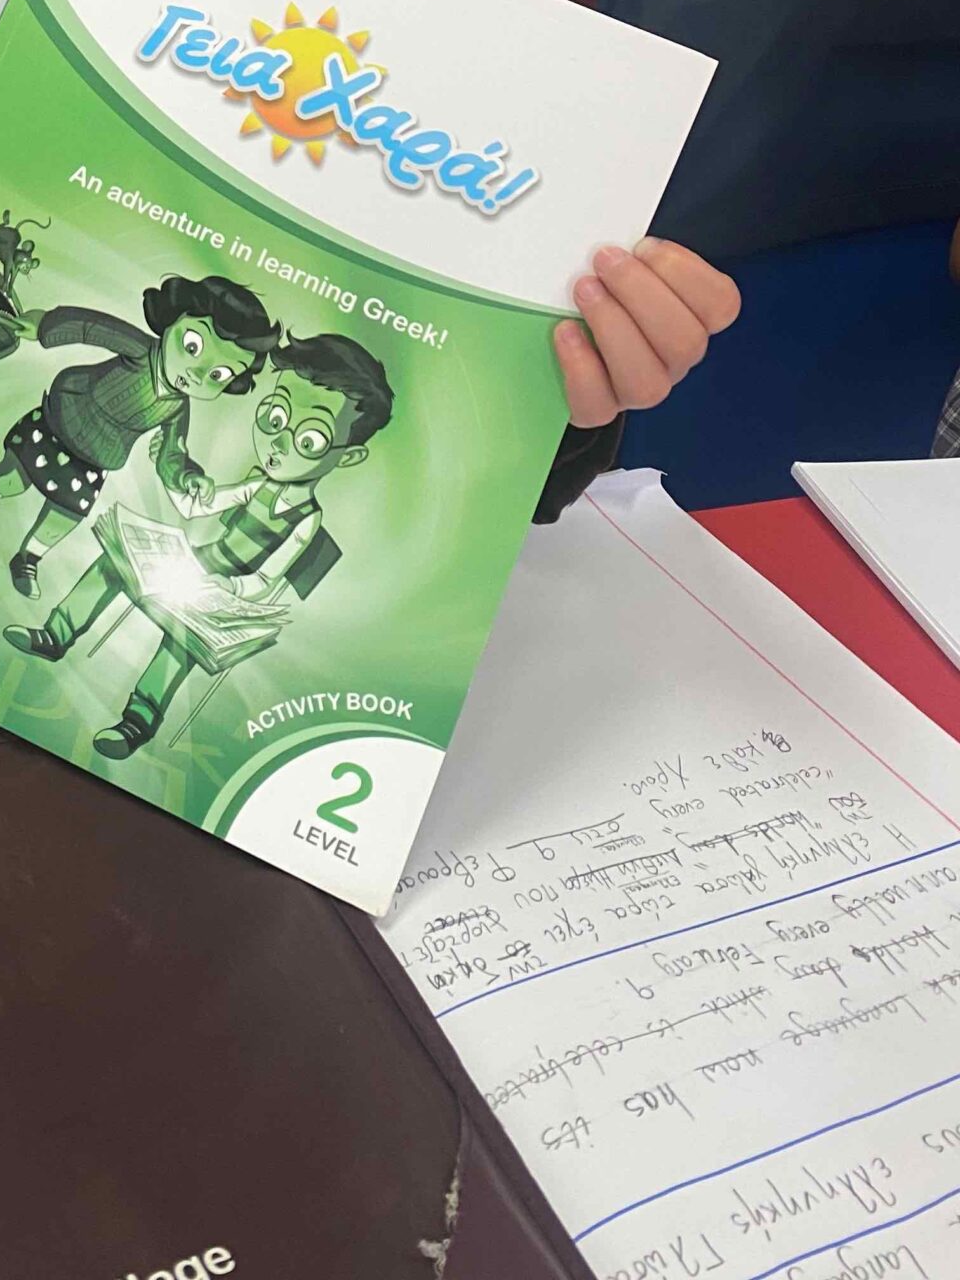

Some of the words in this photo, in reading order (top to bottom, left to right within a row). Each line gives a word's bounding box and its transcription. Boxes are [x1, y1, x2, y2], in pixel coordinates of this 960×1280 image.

[140, 4, 286, 96] Γεια
[299, 57, 537, 211] Χαρά!
[68, 163, 104, 194] An
[106, 176, 227, 251] adventure
[230, 234, 254, 265] in
[256, 245, 358, 315] learning
[361, 295, 451, 352] Greek!
[246, 692, 341, 739] ACTIVITY
[346, 692, 414, 721] BOOK
[316, 762, 374, 835] 2
[292, 819, 361, 867] LEVEL
[765, 920, 831, 947] every
[623, 1082, 695, 1122] has
